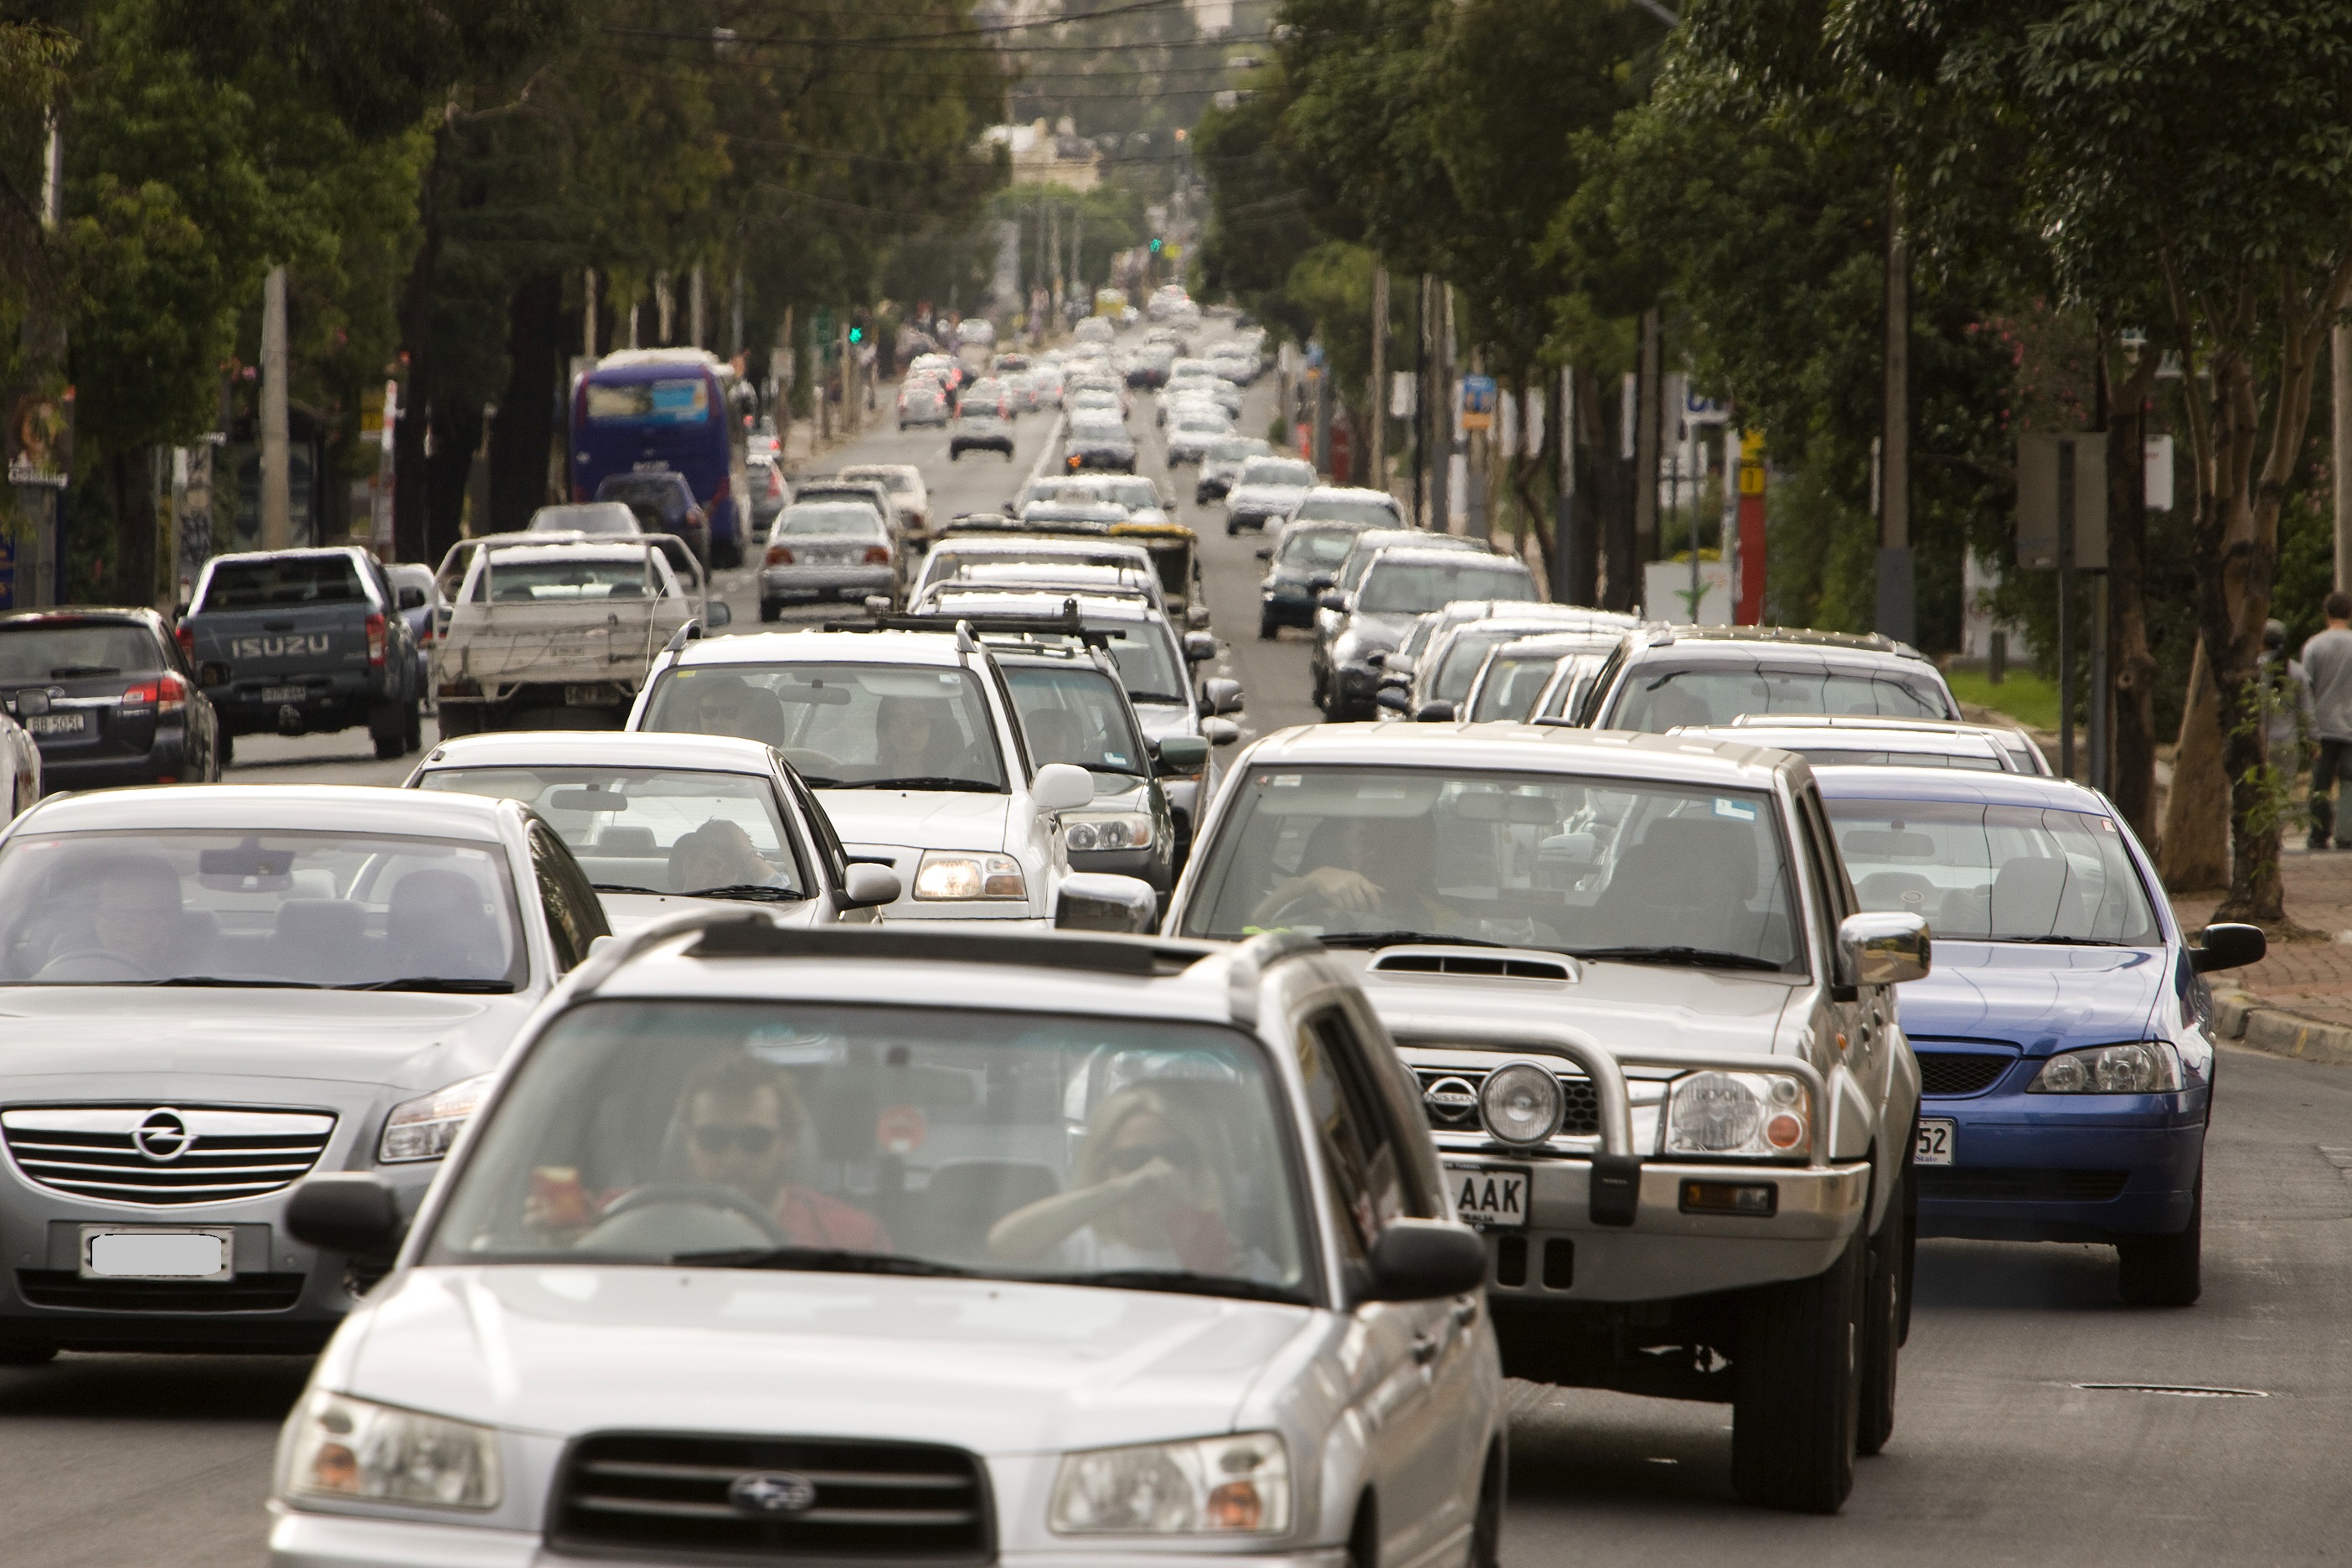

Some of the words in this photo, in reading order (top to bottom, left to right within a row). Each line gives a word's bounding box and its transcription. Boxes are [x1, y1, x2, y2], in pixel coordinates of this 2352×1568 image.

[232, 634, 328, 659] ISUZU
[1431, 1094, 1474, 1103] NISSAN
[1458, 1176, 1521, 1214] AAK
